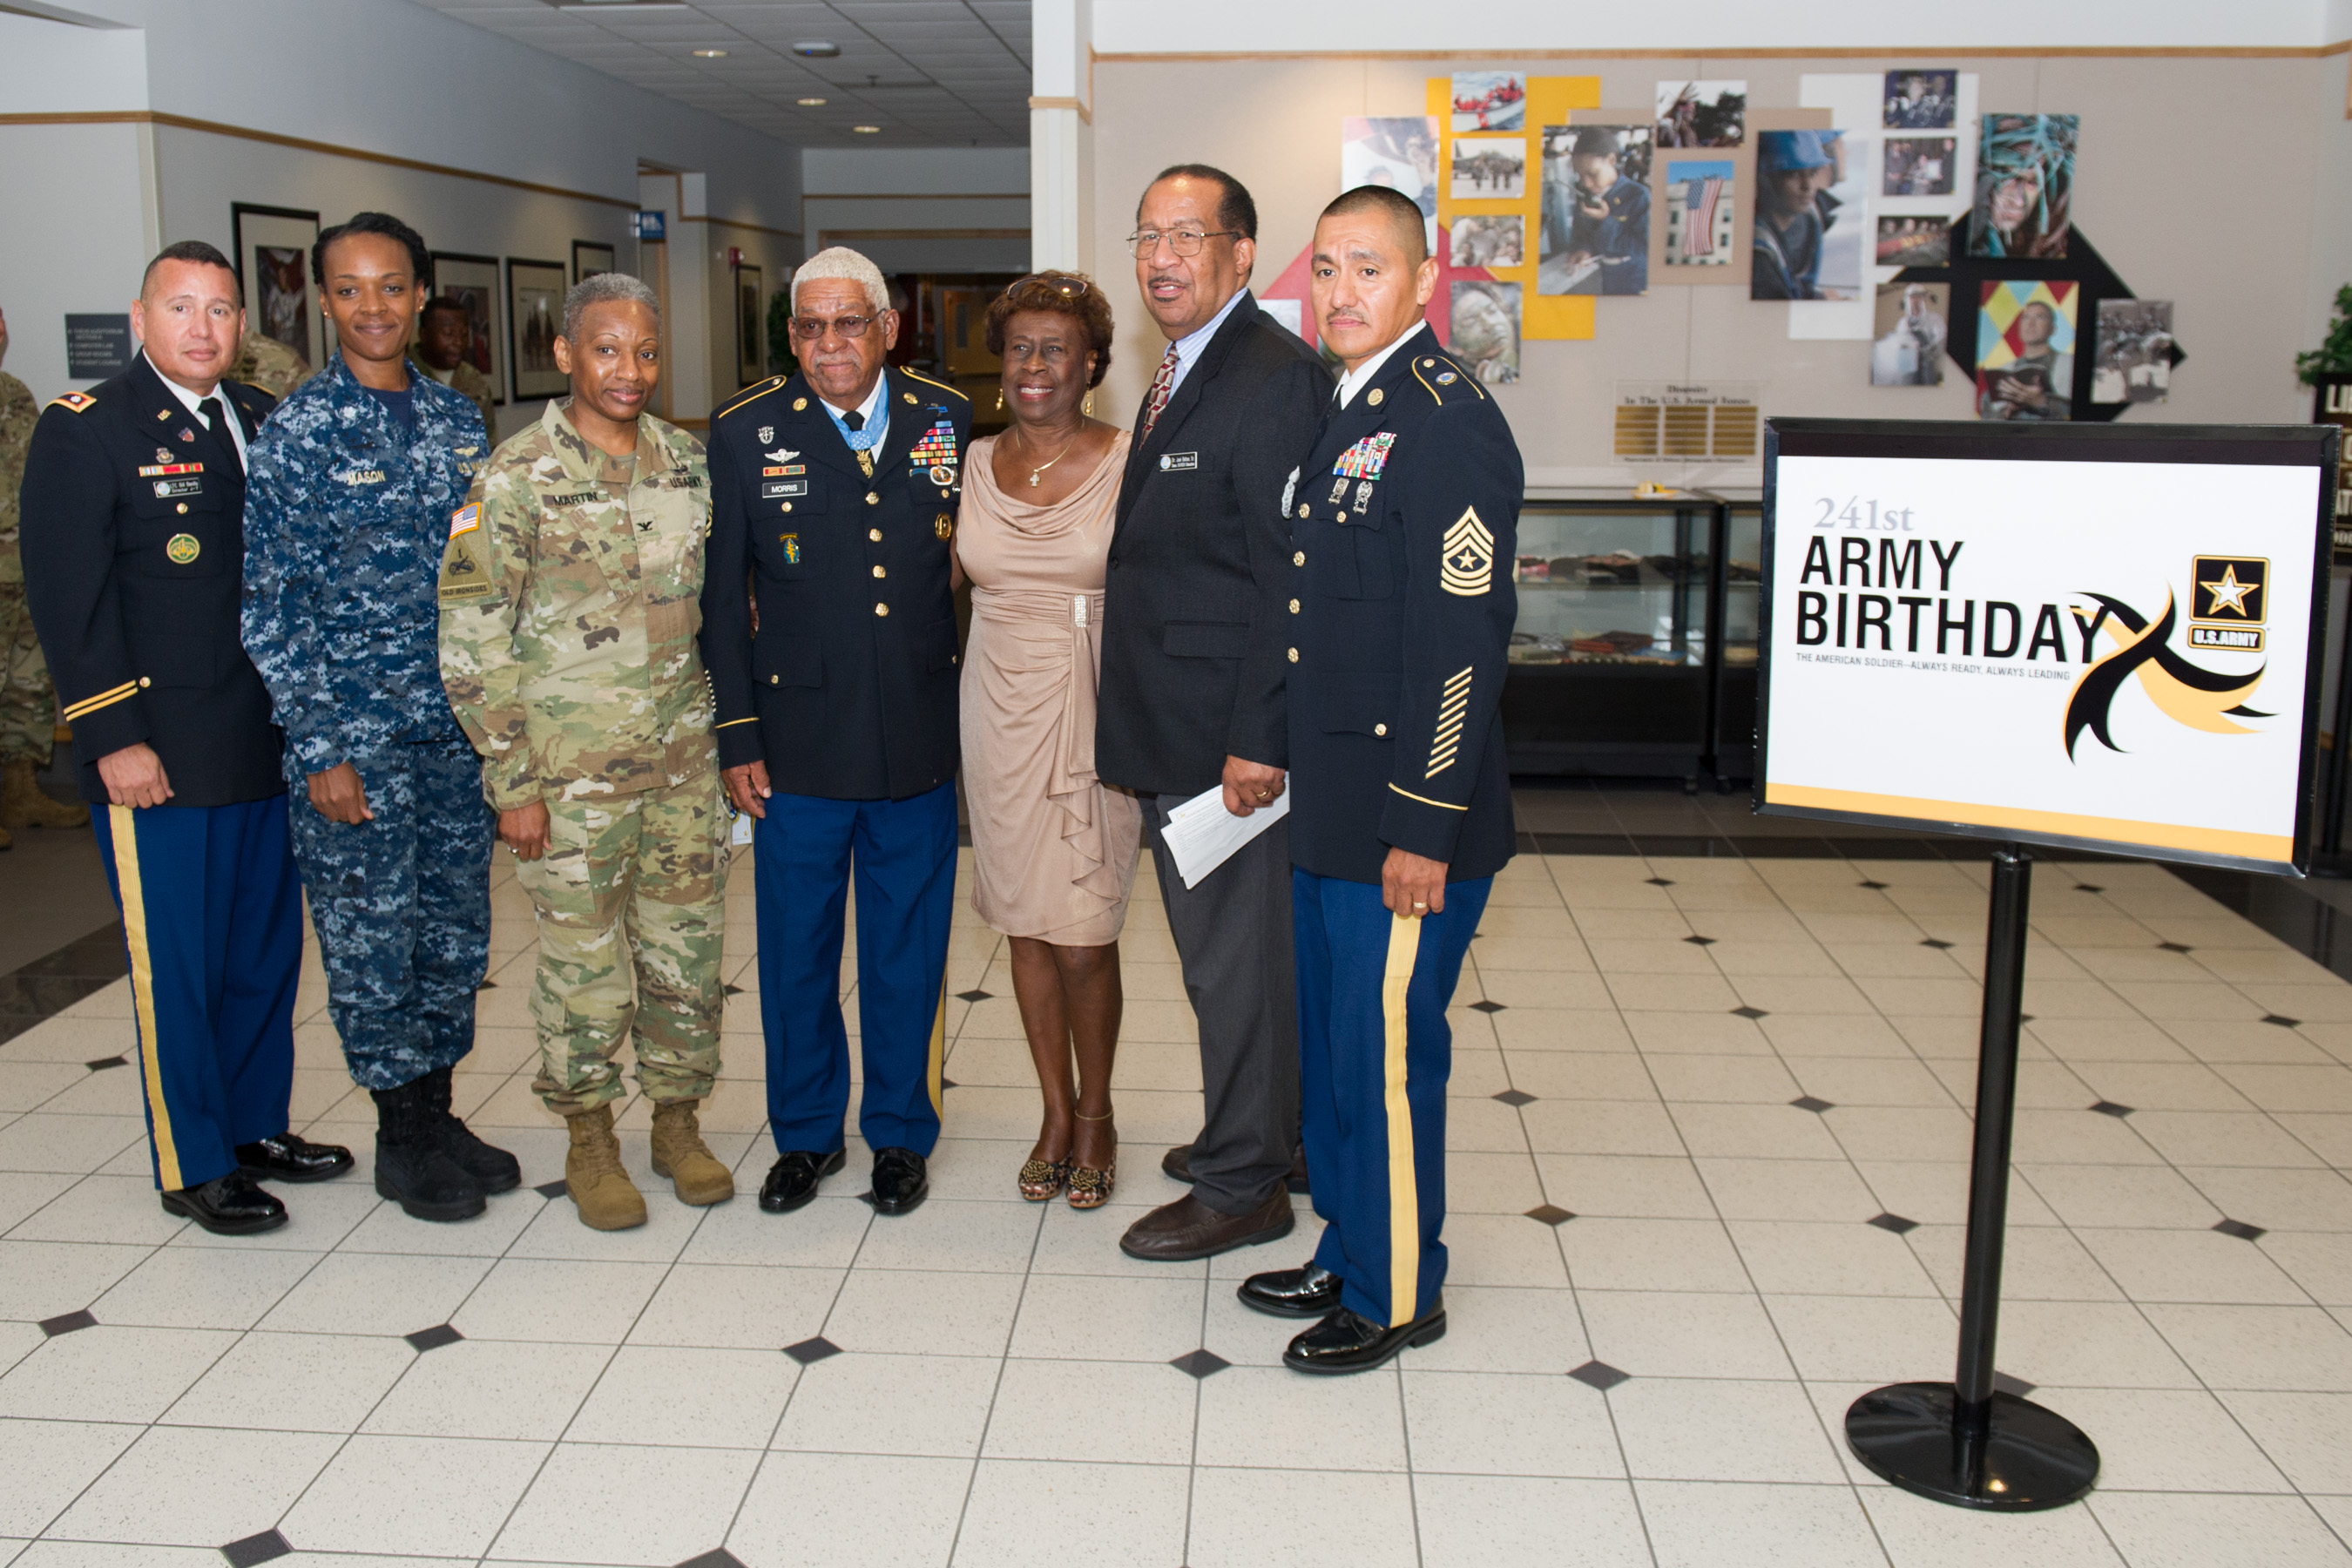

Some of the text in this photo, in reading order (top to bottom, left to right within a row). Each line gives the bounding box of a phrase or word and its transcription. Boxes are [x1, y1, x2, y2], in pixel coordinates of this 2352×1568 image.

[348, 470, 386, 486] MASON
[771, 484, 798, 493] MORRIS
[552, 491, 598, 506] MARTIN
[1813, 495, 1915, 531] 241st
[1800, 535, 1965, 591] ARMY
[456, 585, 488, 595] IRONSIDES
[1796, 591, 2105, 665] BIRTHDAY
[1796, 652, 1813, 662] THE
[1815, 654, 1862, 666] AMERICAN
[1951, 664, 1984, 676] READY,
[1986, 666, 2024, 677] ALWAYS
[2028, 669, 2071, 681] LEADING
